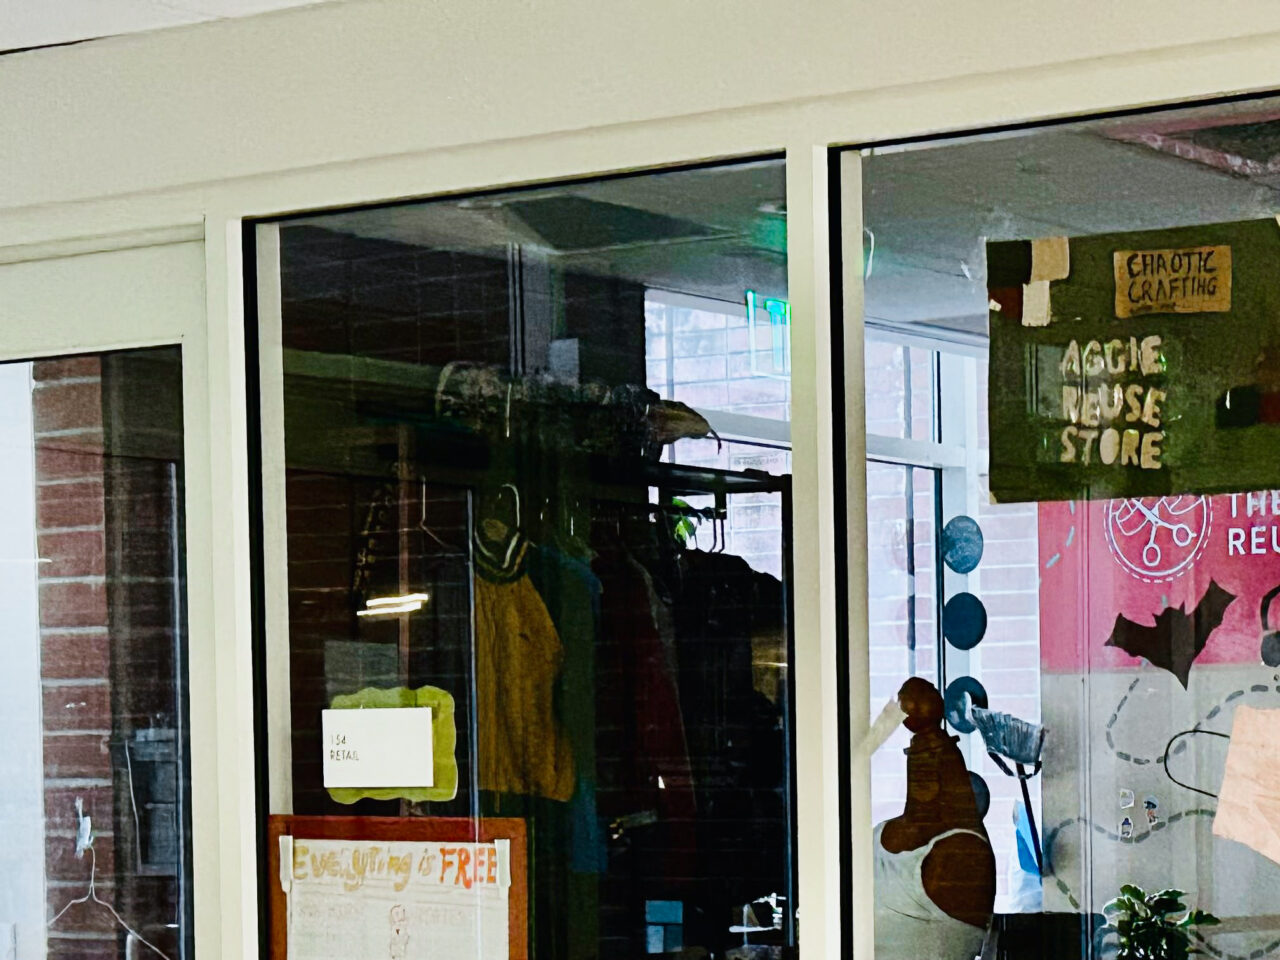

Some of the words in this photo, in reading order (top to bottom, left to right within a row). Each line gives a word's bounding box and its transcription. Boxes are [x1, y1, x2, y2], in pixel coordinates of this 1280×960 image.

[1127, 250, 1216, 278] CHAOTIC
[1127, 276, 1217, 303] CRAFTING
[1060, 335, 1163, 378] AGGIE
[1060, 425, 1164, 469] STORE
[439, 847, 497, 890] FREE
